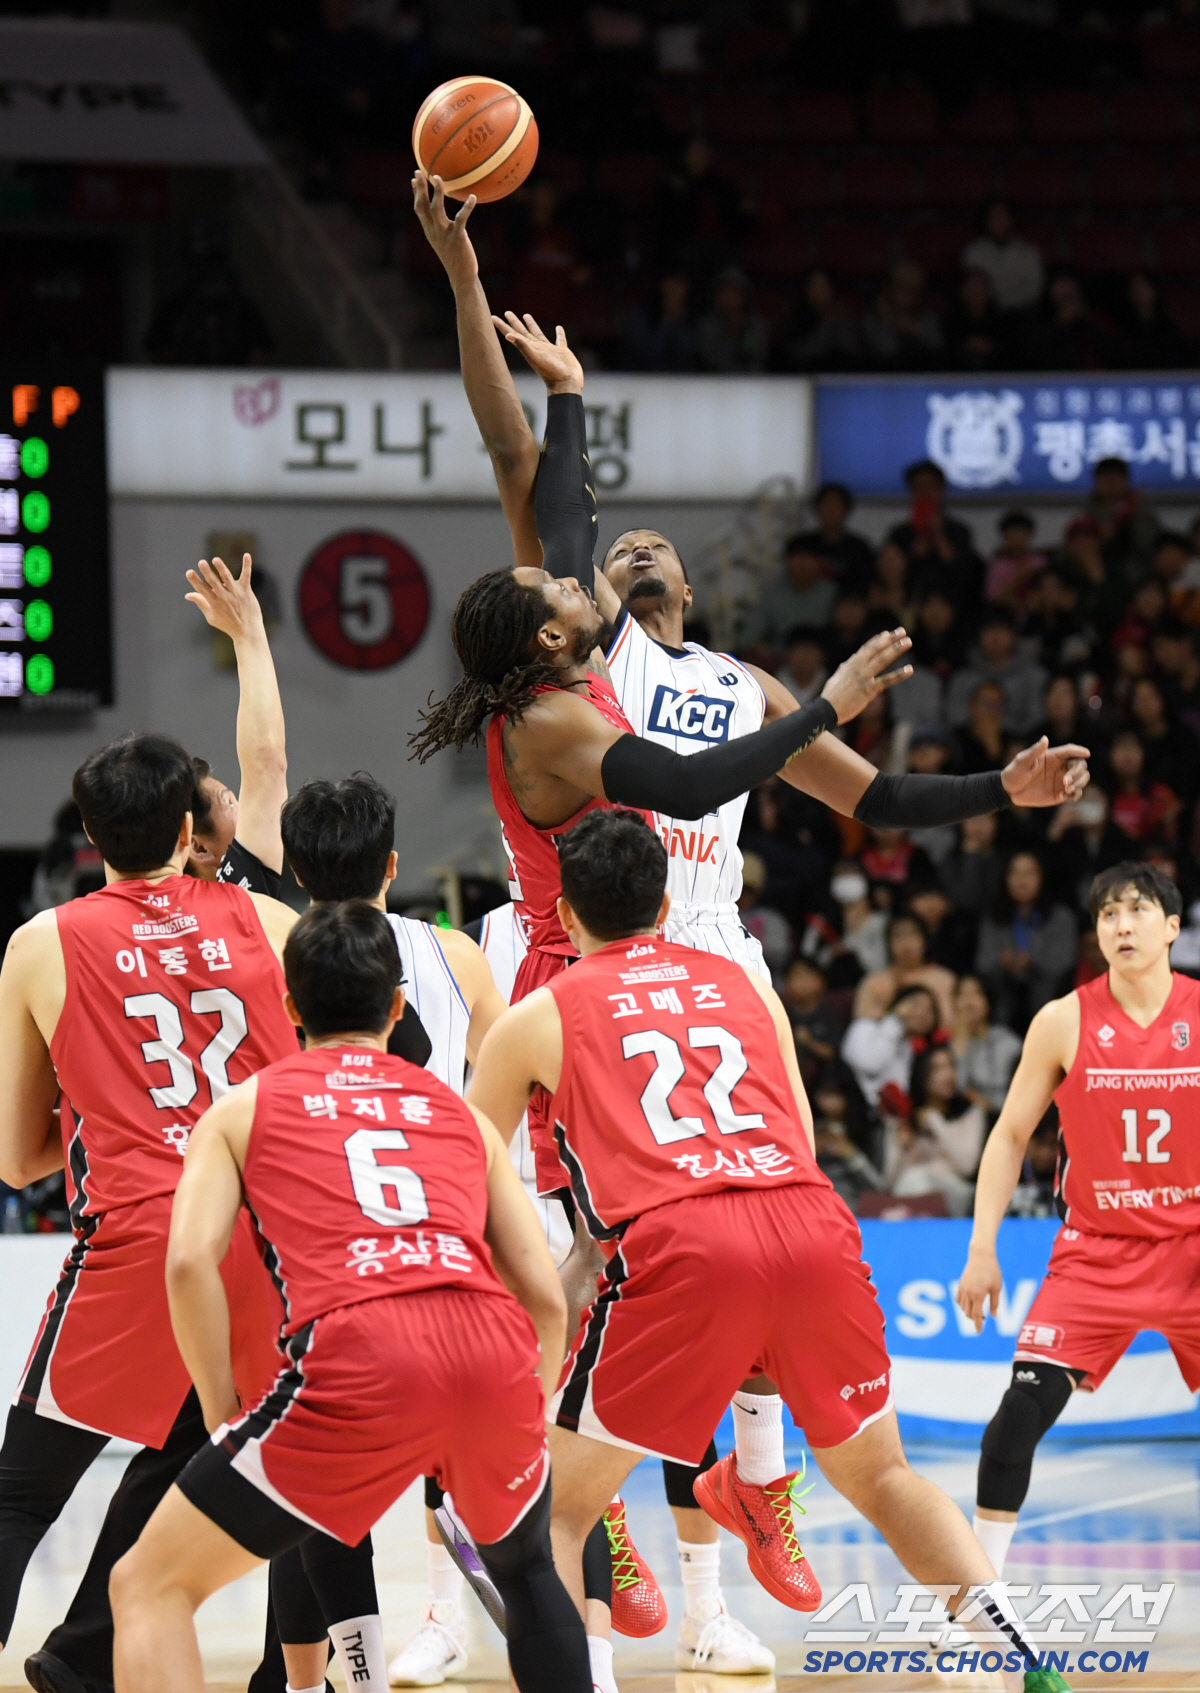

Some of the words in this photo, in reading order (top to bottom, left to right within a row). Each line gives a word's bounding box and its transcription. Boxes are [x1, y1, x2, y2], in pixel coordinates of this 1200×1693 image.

[431, 93, 476, 135] molten
[338, 556, 394, 645] 5
[656, 689, 727, 738] KCC
[132, 924, 151, 935] RED
[152, 914, 198, 935] BOOSTERS
[115, 937, 232, 978] 이종현
[607, 983, 726, 1019] 고메즈
[123, 986, 249, 1110] 32
[621, 1025, 768, 1146] 22
[1086, 1075, 1122, 1093] JUNG
[1124, 1075, 1168, 1092] KWAN
[302, 1094, 433, 1125] 박지훈
[1120, 1108, 1172, 1164] 12
[343, 1128, 430, 1227] 6
[342, 1630, 371, 1683] TYPE
